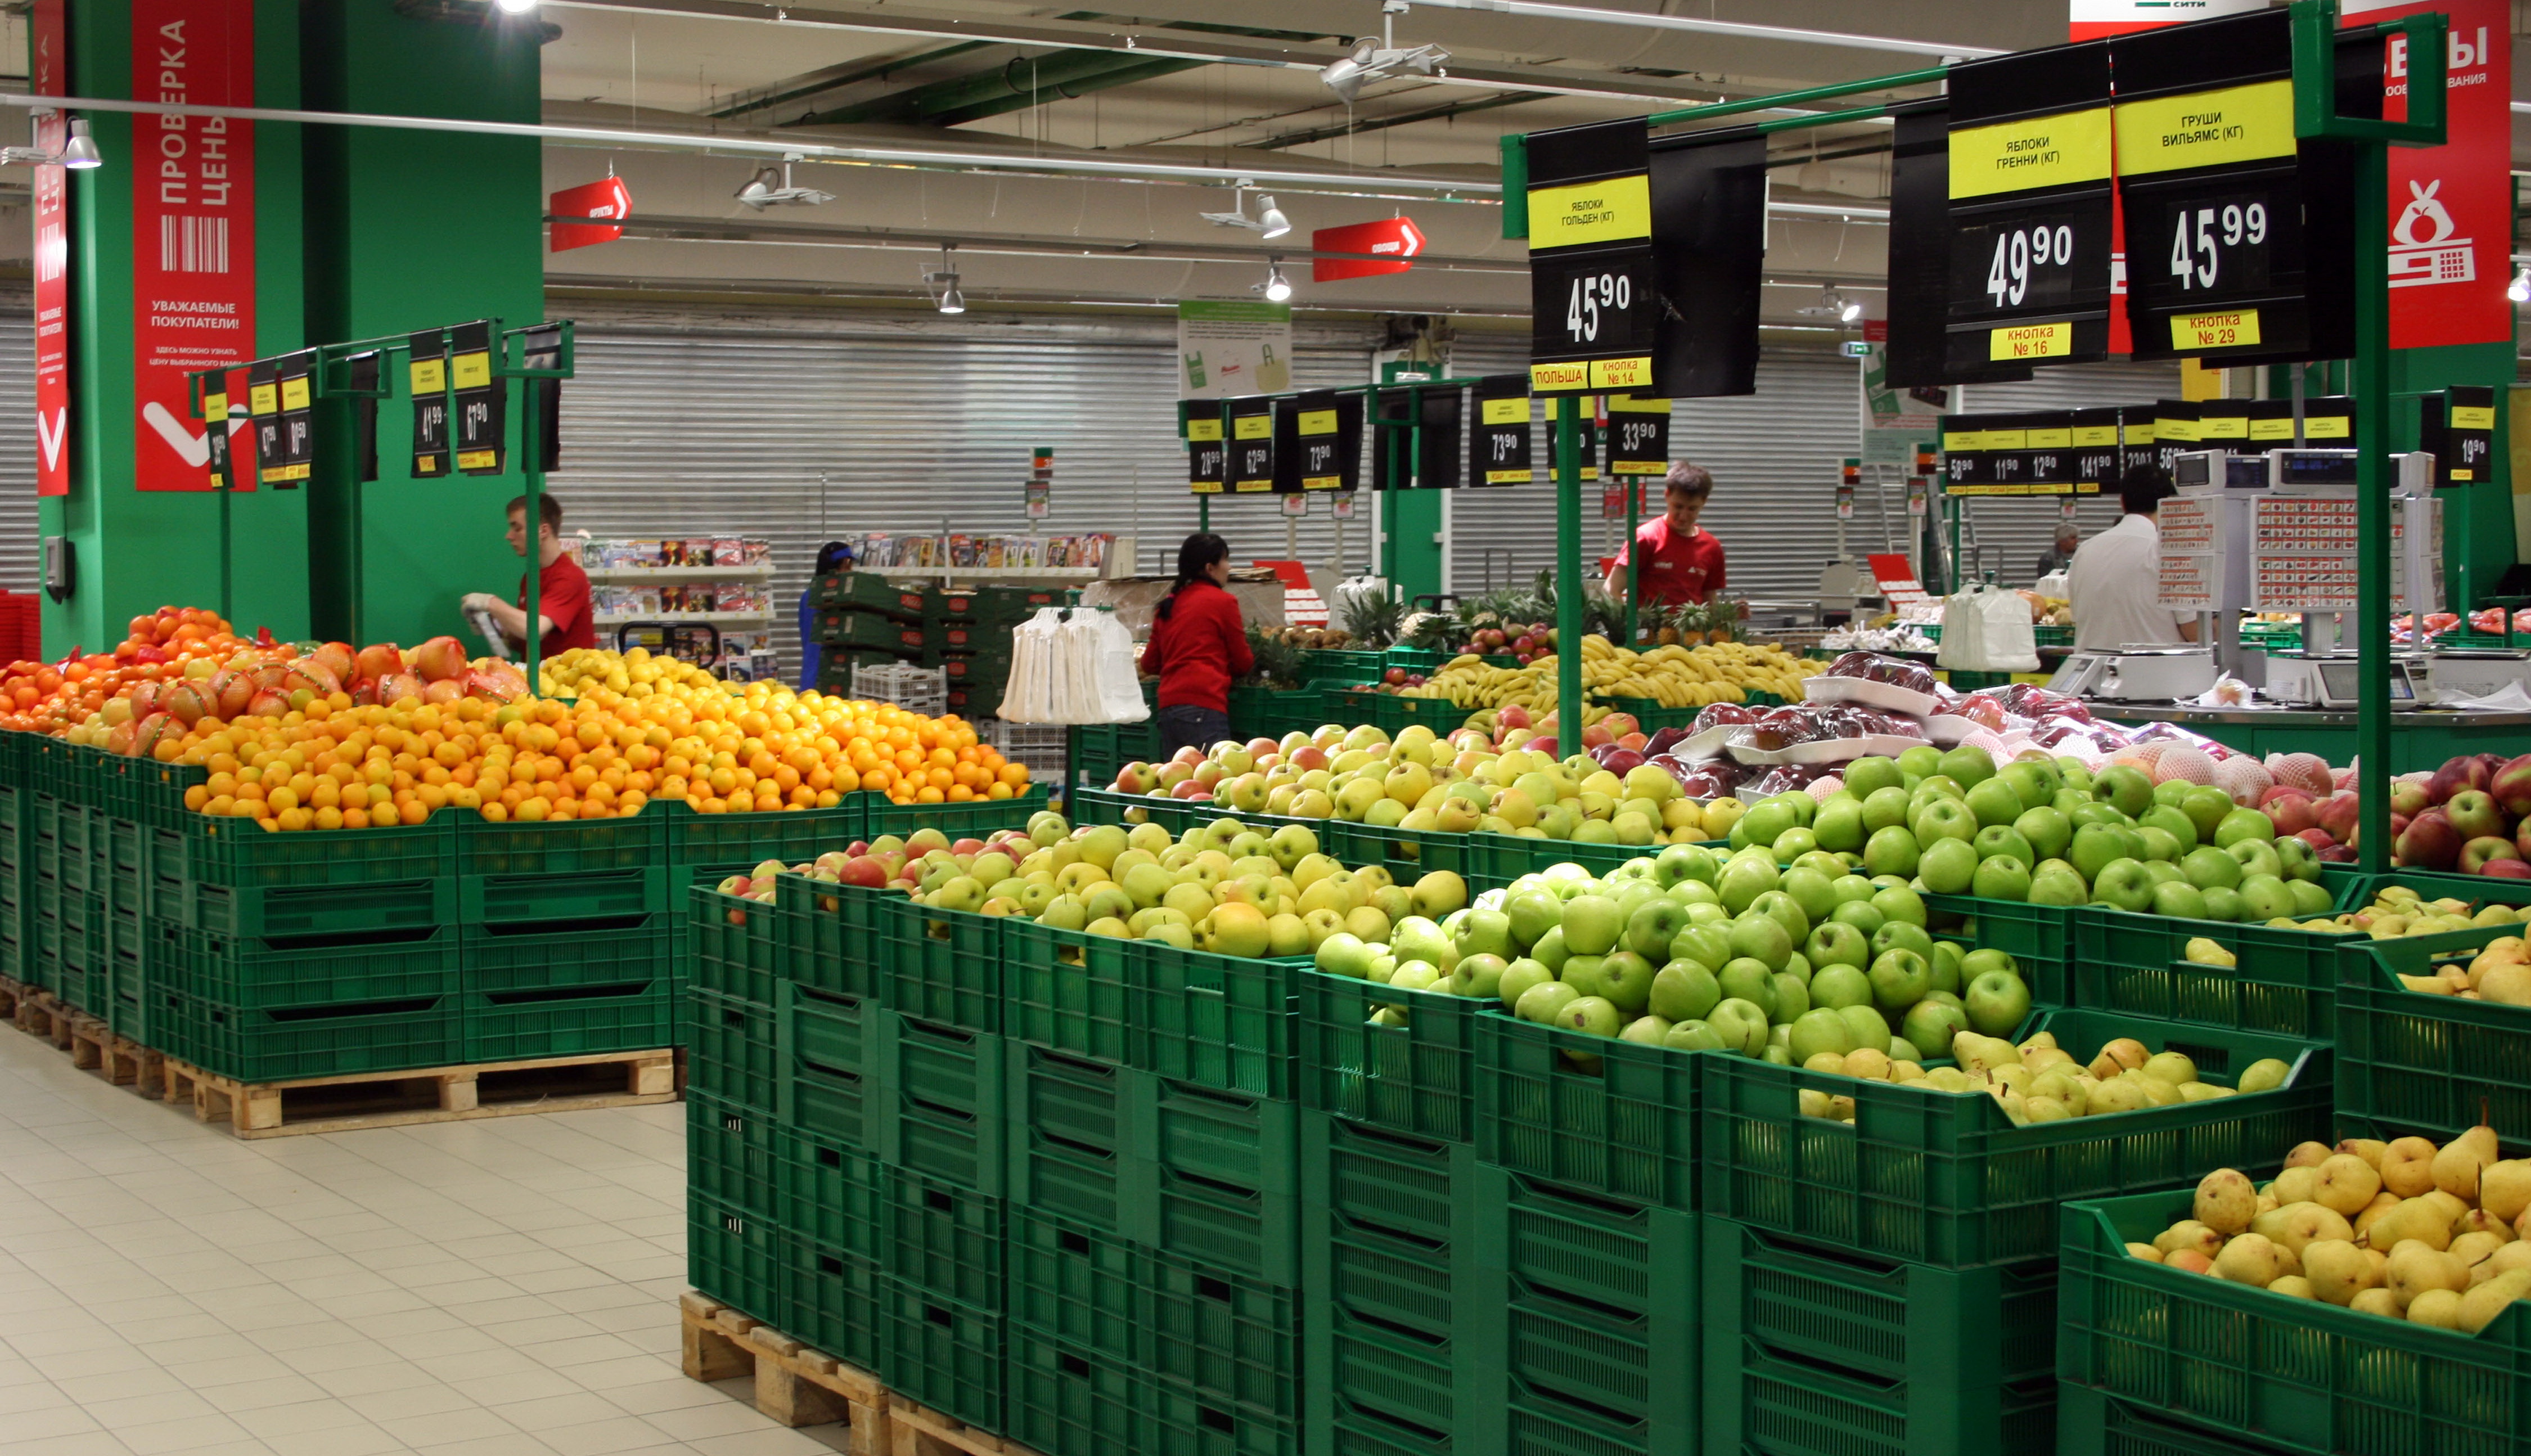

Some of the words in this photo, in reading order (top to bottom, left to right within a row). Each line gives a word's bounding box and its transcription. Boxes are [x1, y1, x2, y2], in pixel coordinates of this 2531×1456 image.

[2181, 112, 2222, 128] ГРУШИ
[2162, 128, 2219, 147] ВИЛЬЯМС
[2222, 125, 2244, 142] (КГ)
[2006, 137, 2049, 153] ЯБЛОКИ
[1997, 154, 2038, 170] ГРЕННИ
[2041, 150, 2060, 166] (КГ)
[1571, 199, 1603, 211] ЯБЛОКИ
[1562, 213, 1598, 226] ГОЛЬДЕН
[1600, 211, 1614, 223] (КГ)
[152, 300, 236, 313] УВАЖАЕМЫЕ
[151, 316, 240, 330] ПОКУПАТЕЛИ!
[2190, 314, 2241, 329] кнопка
[2008, 326, 2054, 340] кнопка
[2219, 329, 2235, 344] 29
[2033, 341, 2048, 354] 16
[1603, 359, 1637, 372] кнопка
[1535, 369, 1583, 385] ПОЛЬША
[1622, 371, 1634, 384] 14
